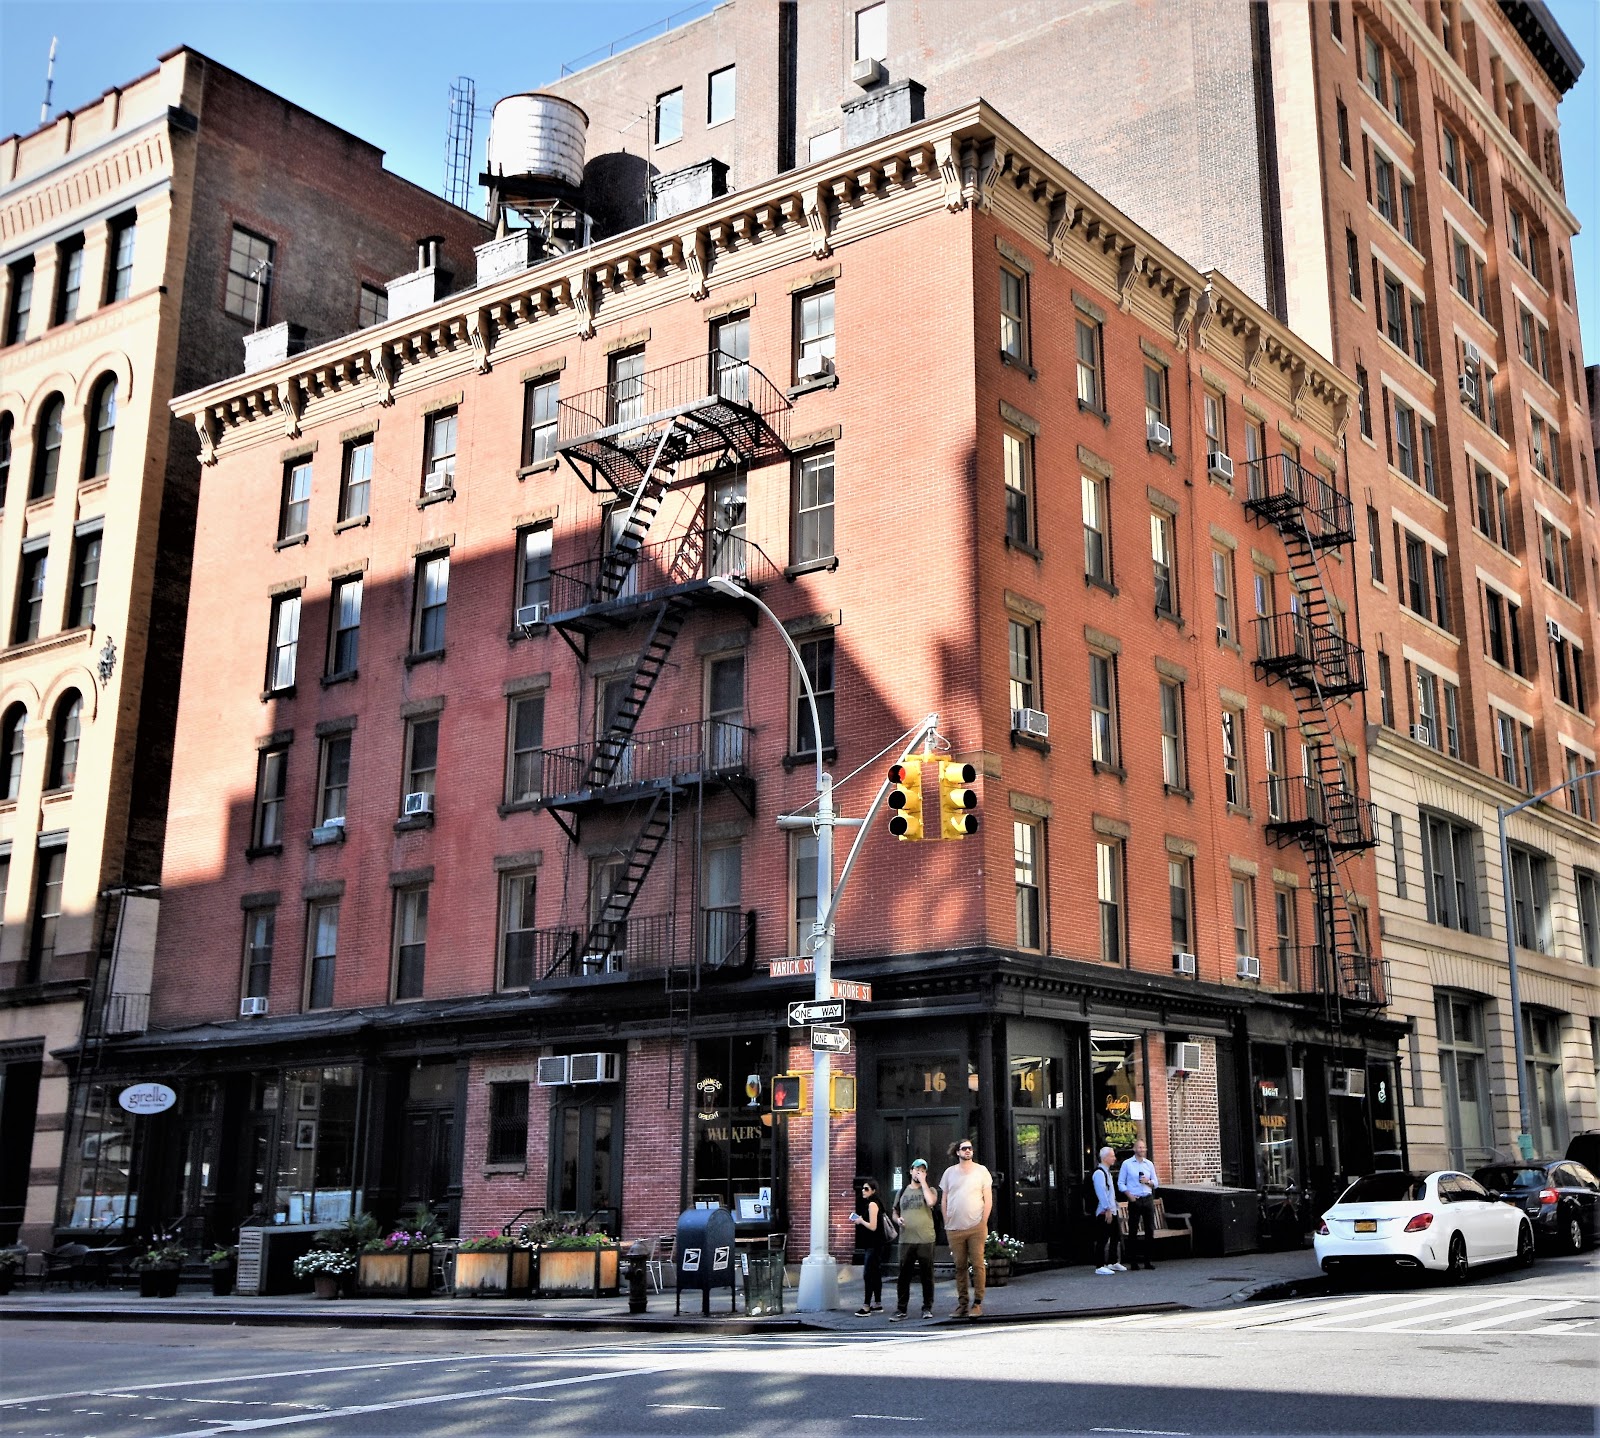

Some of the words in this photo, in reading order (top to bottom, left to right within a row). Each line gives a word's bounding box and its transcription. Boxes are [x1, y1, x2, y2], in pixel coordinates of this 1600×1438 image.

[772, 960, 800, 976] VARICK
[803, 959, 813, 973] ST
[837, 983, 860, 999] MOORE
[862, 986, 870, 1000] ST
[794, 1009, 812, 1019] ONE
[821, 1006, 839, 1017] WAY
[814, 1034, 828, 1044] ONE
[833, 1037, 845, 1046] WAY
[923, 1072, 947, 1092] 16
[1019, 1071, 1035, 1092] 16
[128, 1086, 167, 1108] girello
[761, 1190, 769, 1201] A
